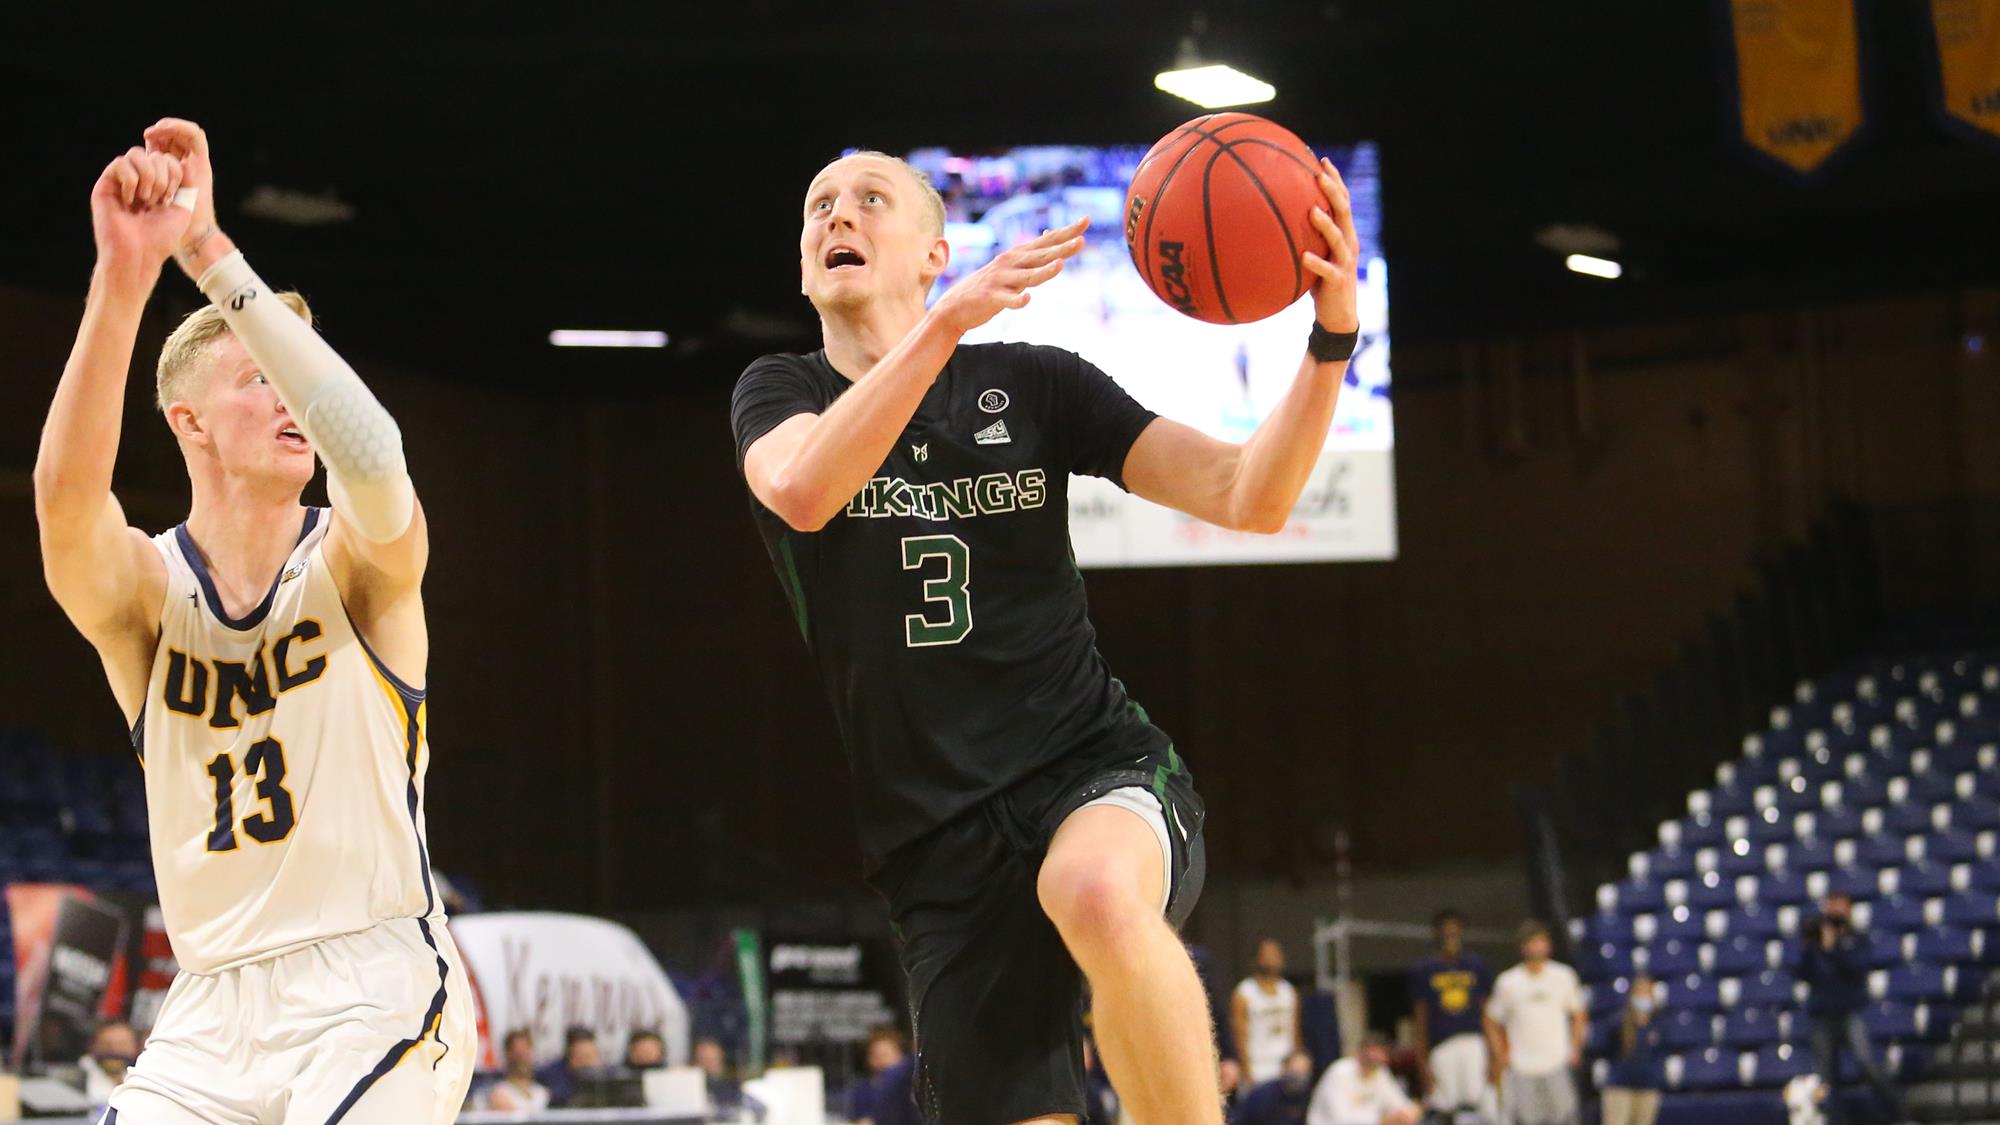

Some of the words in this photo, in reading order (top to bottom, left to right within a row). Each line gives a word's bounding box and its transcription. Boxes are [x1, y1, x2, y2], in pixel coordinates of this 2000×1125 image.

[847, 468, 1047, 522] IKINGS
[901, 534, 973, 648] 3
[163, 618, 328, 730] UNC
[205, 734, 297, 853] 13
